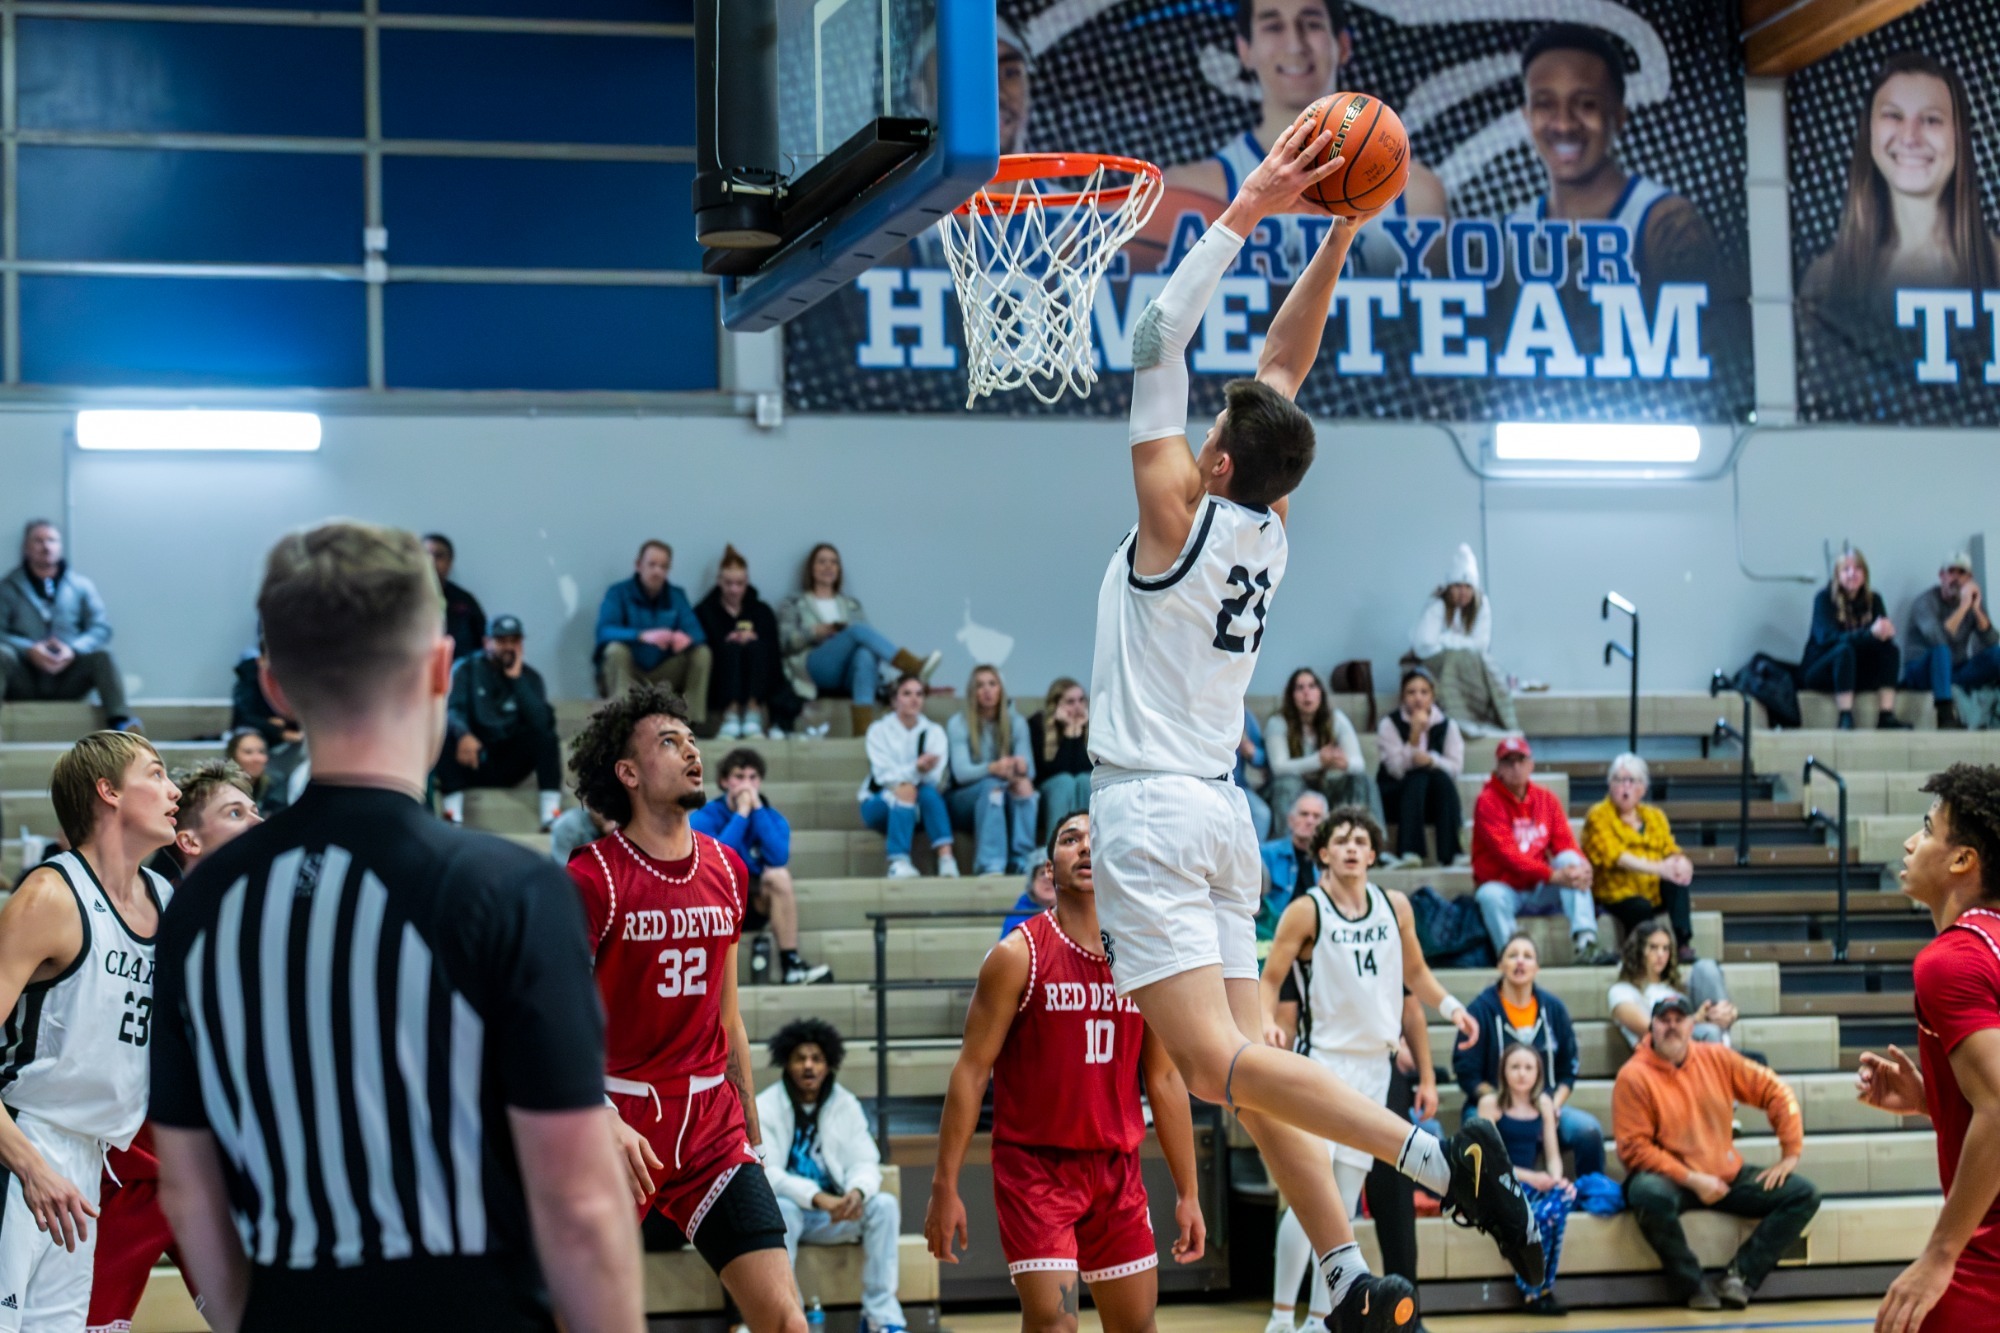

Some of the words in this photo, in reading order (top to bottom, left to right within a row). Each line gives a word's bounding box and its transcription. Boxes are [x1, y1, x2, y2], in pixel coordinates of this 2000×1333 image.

[1328, 106, 1361, 161] ELITE
[1382, 217, 1641, 290] YOUR
[1328, 278, 1712, 379] TEAM
[1213, 564, 1272, 653] 21
[622, 909, 668, 942] RED
[670, 905, 735, 940] DEVILS
[1331, 925, 1388, 943] CLARK
[657, 946, 708, 999] 32
[1354, 948, 1378, 977] 14
[118, 990, 154, 1048] 23
[1044, 981, 1087, 1012] RED
[1084, 1018, 1116, 1065] 10
